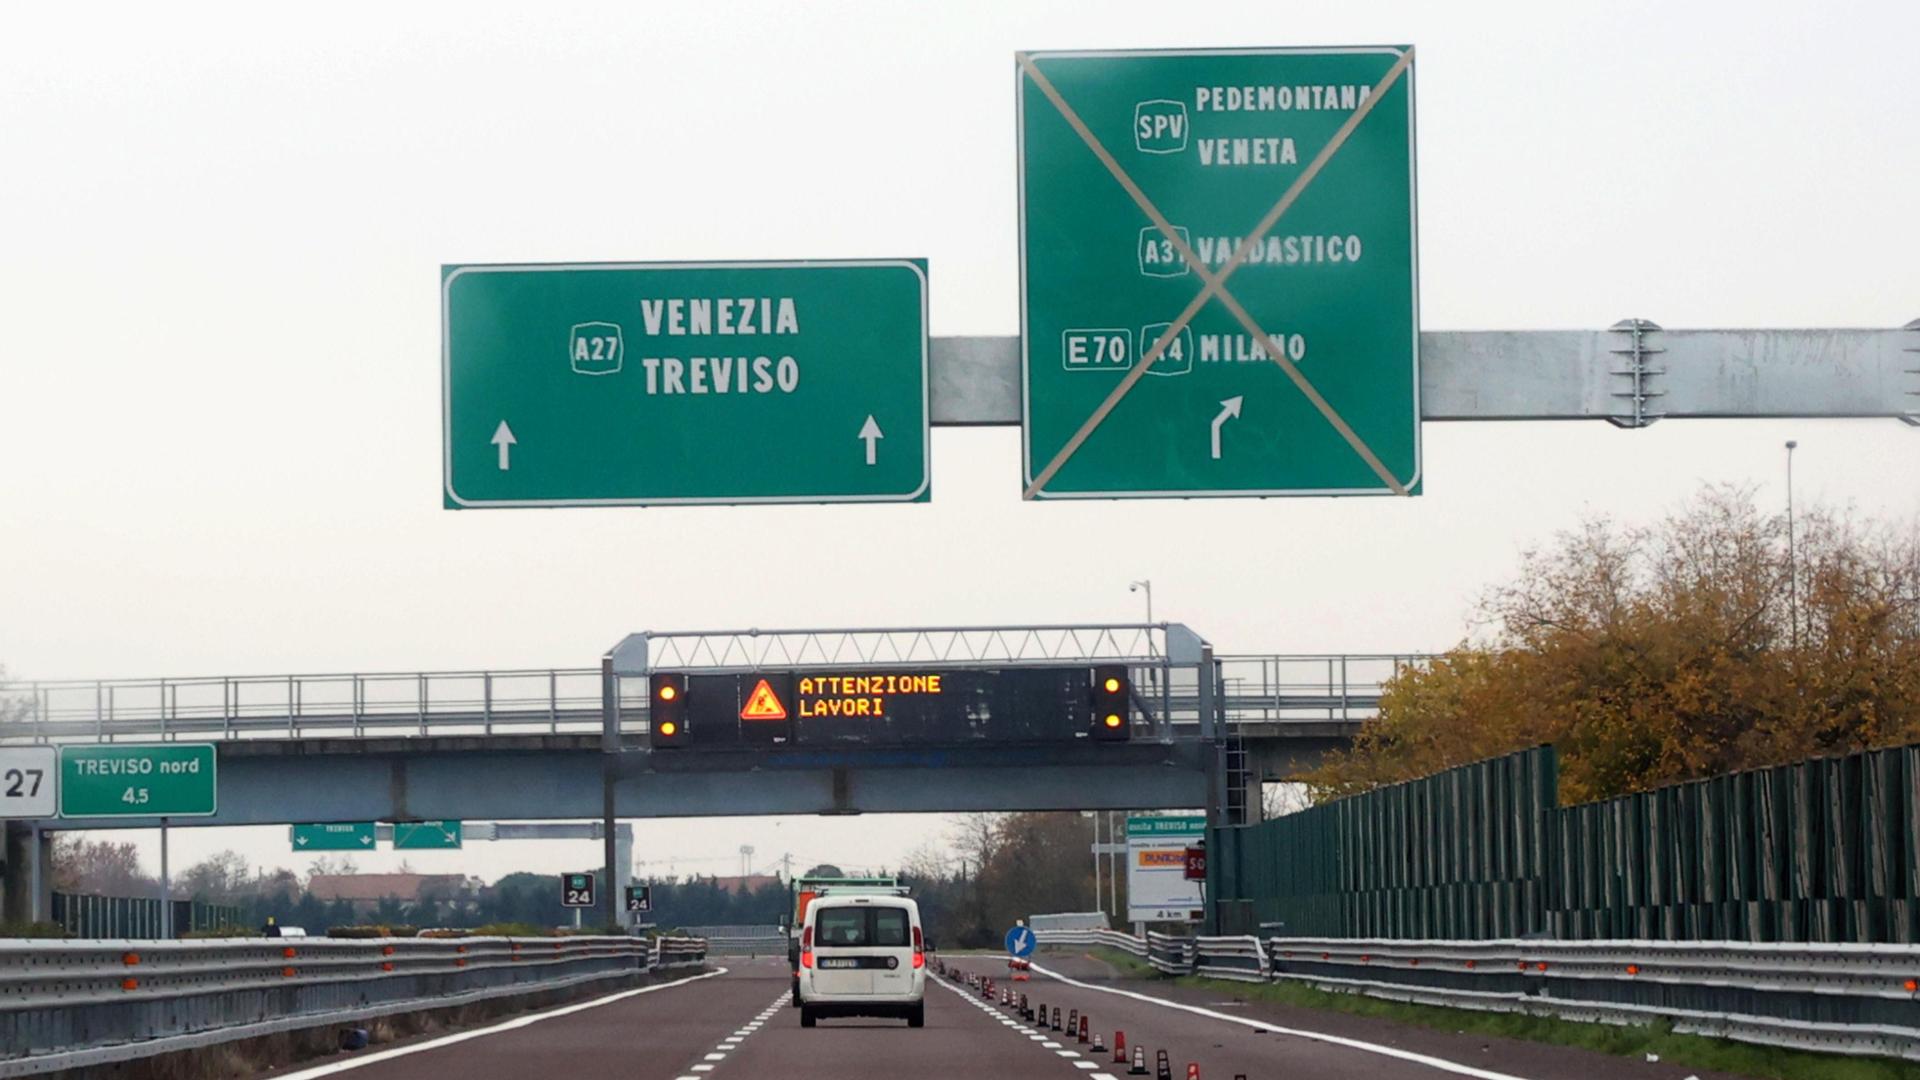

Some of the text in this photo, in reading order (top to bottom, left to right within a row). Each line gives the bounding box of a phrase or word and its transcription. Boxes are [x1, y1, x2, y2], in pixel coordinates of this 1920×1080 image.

[1139, 114, 1183, 139] SPV
[1198, 138, 1297, 165] VENETA
[640, 298, 799, 335] VENEZIA
[575, 336, 618, 361] A27
[1200, 333, 1306, 362] MILANO
[642, 355, 799, 394] TREVISO
[799, 675, 941, 694] ATTENZIONE
[799, 698, 884, 717] LAVORI
[74, 757, 200, 775] TREVISO nord
[568, 890, 590, 903] 24
[630, 899, 648, 910] 24
[1167, 910, 1182, 918] km
